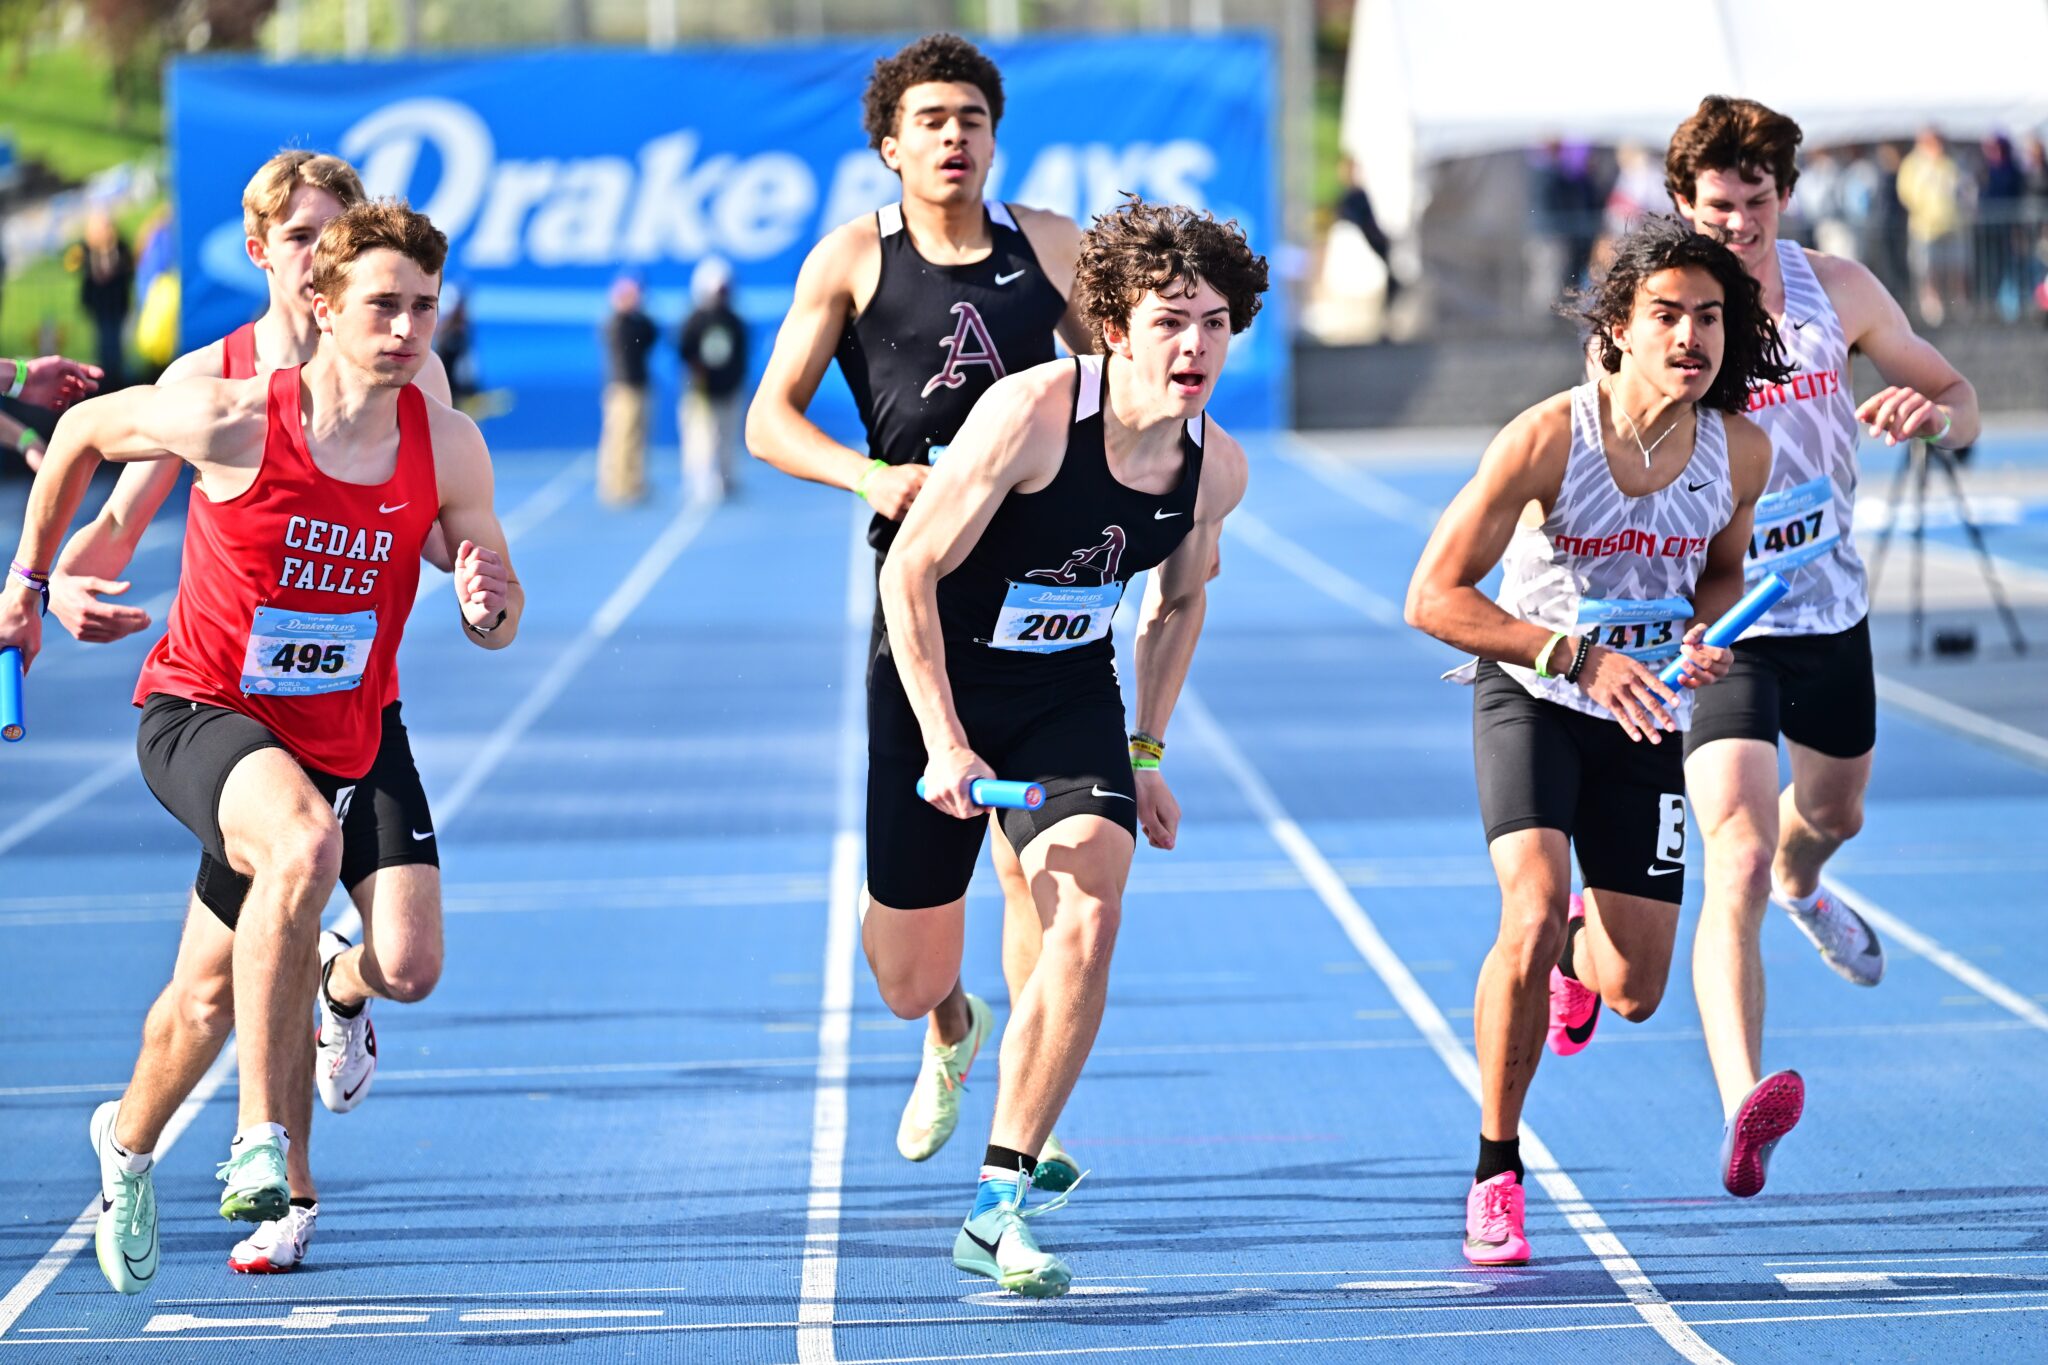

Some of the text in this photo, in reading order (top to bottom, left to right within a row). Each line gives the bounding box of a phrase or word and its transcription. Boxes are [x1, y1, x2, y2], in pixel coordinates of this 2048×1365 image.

[340, 97, 1221, 268] Drake RAYS
[921, 300, 1008, 399] A
[1792, 368, 1839, 401] CITY
[284, 515, 394, 562] CEDAR
[1555, 528, 1657, 558] MASON
[278, 556, 379, 595] FALLS
[1039, 591, 1074, 602] Drake
[285, 619, 325, 631] Drake
[324, 624, 356, 634] RELAYS
[1017, 614, 1092, 641] 200
[1586, 620, 1673, 650] 1413
[271, 643, 346, 674] 495
[1666, 798, 1686, 860] 3
